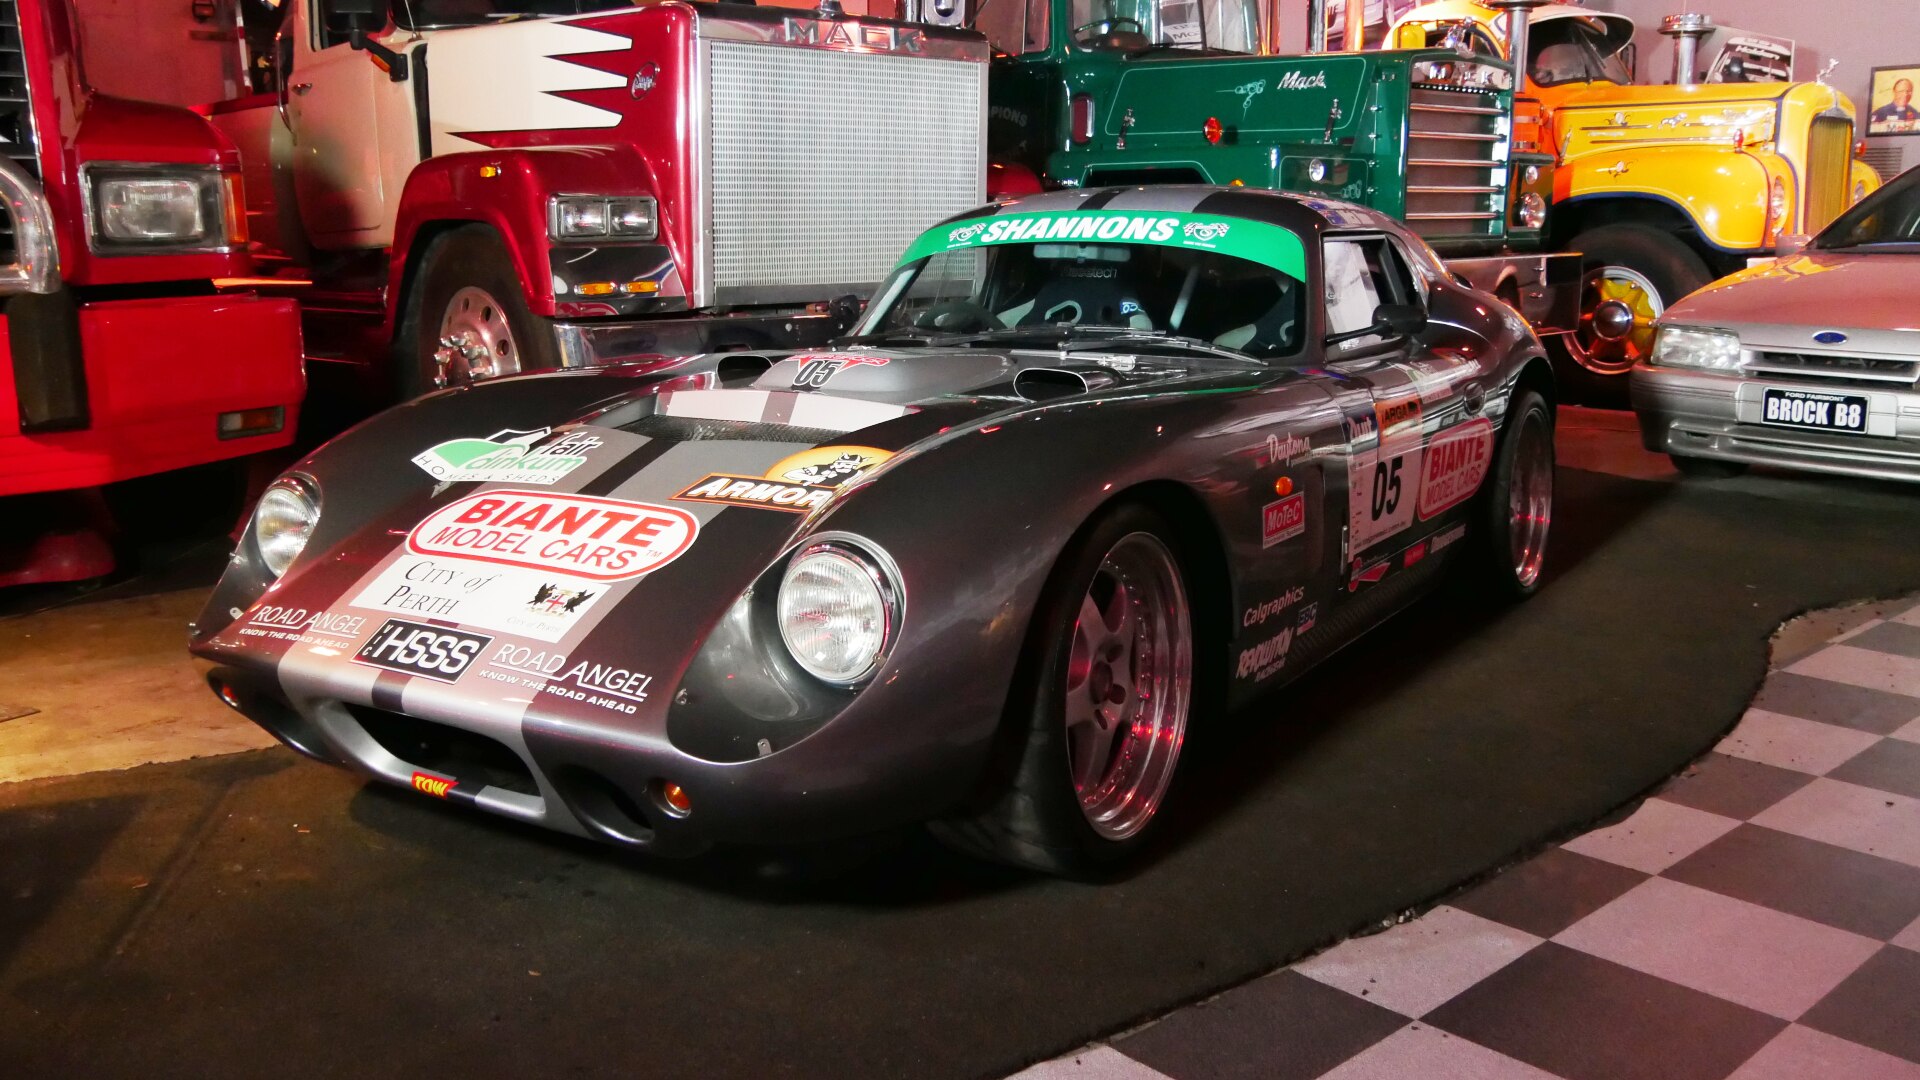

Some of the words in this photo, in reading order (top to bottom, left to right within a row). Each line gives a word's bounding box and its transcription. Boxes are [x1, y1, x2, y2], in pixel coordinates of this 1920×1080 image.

[784, 17, 926, 53] MACK
[1277, 70, 1327, 90] Mack
[987, 105, 1028, 127] PIONS
[981, 216, 1180, 242] SHANNONS
[793, 359, 847, 387] 05
[1785, 391, 1805, 399] FORD
[1806, 393, 1845, 402] FAIRMONT
[1767, 397, 1830, 425] BROCK
[1834, 403, 1861, 428] B8
[465, 447, 585, 471] dinkum
[540, 432, 604, 456] fair
[1267, 432, 1311, 467] Daytona
[1429, 433, 1485, 482] BIANTE
[417, 454, 476, 480] HOMES
[502, 472, 562, 484] SHEDS
[1372, 455, 1403, 521] 05
[1425, 476, 1455, 507] MODEL
[1457, 464, 1482, 491] CARS
[454, 498, 676, 548] BIANTE
[1267, 501, 1301, 533] MoTeC
[427, 526, 534, 555] MODEL
[540, 539, 637, 570] CARS
[464, 573, 502, 594] of
[384, 585, 460, 615] PERTH
[1244, 586, 1304, 627] Calgraphics
[252, 605, 307, 626] ROAD
[300, 612, 367, 636] ANGEL
[239, 628, 268, 637] KNOW
[269, 631, 286, 639] THE
[286, 633, 313, 642] ROAD
[312, 637, 350, 649] AHEAD
[362, 624, 392, 656] VIC
[372, 626, 480, 674] HSSS
[492, 643, 567, 675] ROAD
[563, 660, 653, 698] ANGEL
[479, 670, 519, 684] KNOW
[522, 679, 547, 691] THE
[546, 685, 586, 701] ROAD
[586, 696, 637, 714] AHEAD
[415, 775, 449, 797] TOW
